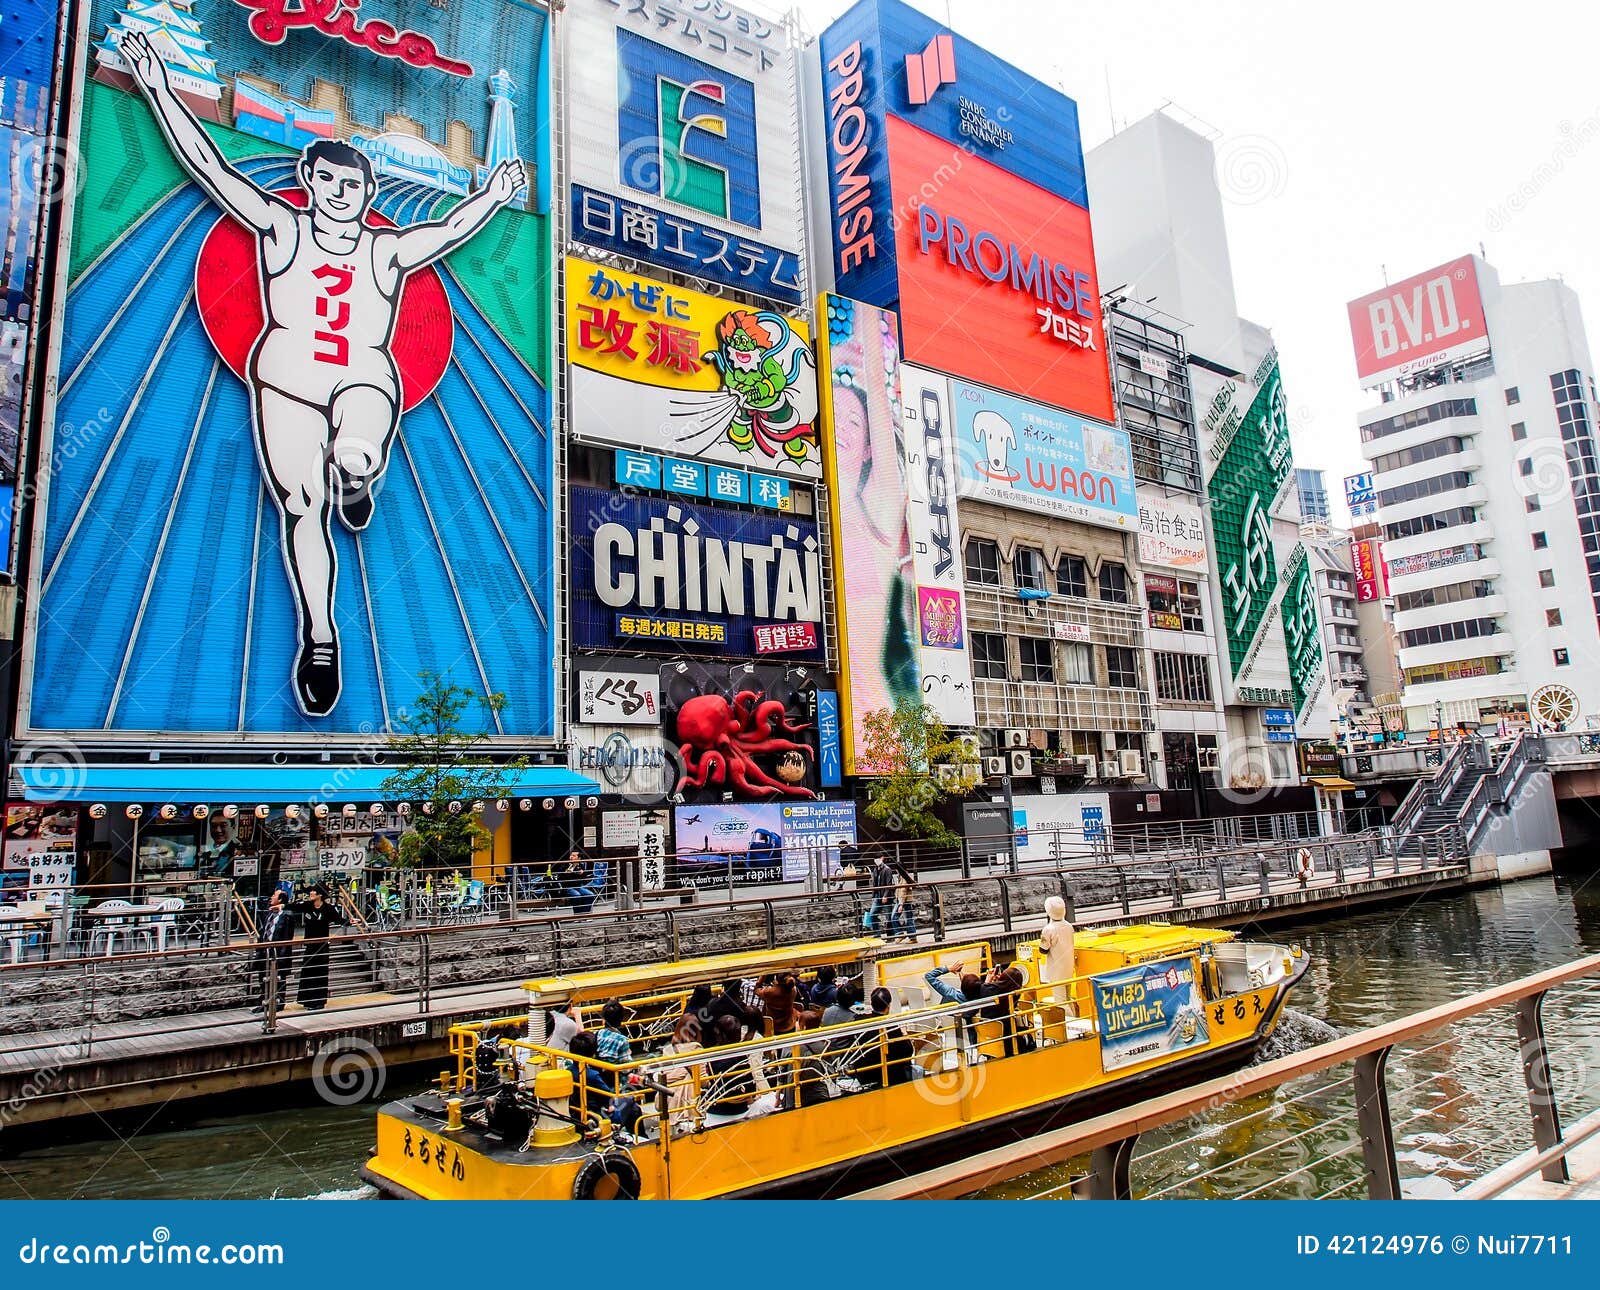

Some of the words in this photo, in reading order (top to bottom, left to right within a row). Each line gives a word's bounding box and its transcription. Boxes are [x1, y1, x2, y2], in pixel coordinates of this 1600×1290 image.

[606, 0, 774, 71] ステムコート
[959, 96, 986, 118] SMBC
[960, 107, 1014, 145] CONSUMER
[961, 119, 1005, 151] FINANCE
[828, 40, 876, 275] PROMISE
[582, 190, 800, 292] 日商エステム
[918, 204, 1094, 320] PROMISE
[587, 269, 691, 321] かぜに
[312, 261, 356, 367] グリコ
[1368, 275, 1471, 360] B.V.D.
[576, 302, 703, 375] 改源
[1036, 307, 1097, 351] プロミス
[1410, 352, 1448, 371] FUJIBO
[625, 454, 783, 502] 戸堂歯科
[1026, 457, 1117, 506] WAON
[780, 498, 789, 509] 3F
[594, 504, 822, 623] CHINTAI
[1361, 542, 1373, 580] カラオケ
[1361, 583, 1373, 600] 3
[619, 616, 724, 642] 毎週水曜日発売
[756, 626, 789, 651] 賃貸
[787, 625, 805, 638] 住宅
[788, 634, 816, 649] ニュース
[926, 630, 957, 646] Girls
[595, 677, 645, 716] くくる
[809, 690, 817, 717] 2F
[784, 822, 791, 830] to
[792, 819, 815, 830] Kansai
[830, 818, 853, 830] Airport
[809, 806, 829, 819] Rapid
[830, 805, 852, 818] Express
[1083, 818, 1104, 832] CITY
[30, 853, 75, 867] お好み焼
[320, 851, 364, 869] 串カツ
[33, 873, 69, 885] 串カツ
[697, 875, 711, 885] don't
[712, 874, 723, 884] you
[1101, 983, 1145, 1010] とんぼり
[403, 1127, 465, 1182] えちぜん
